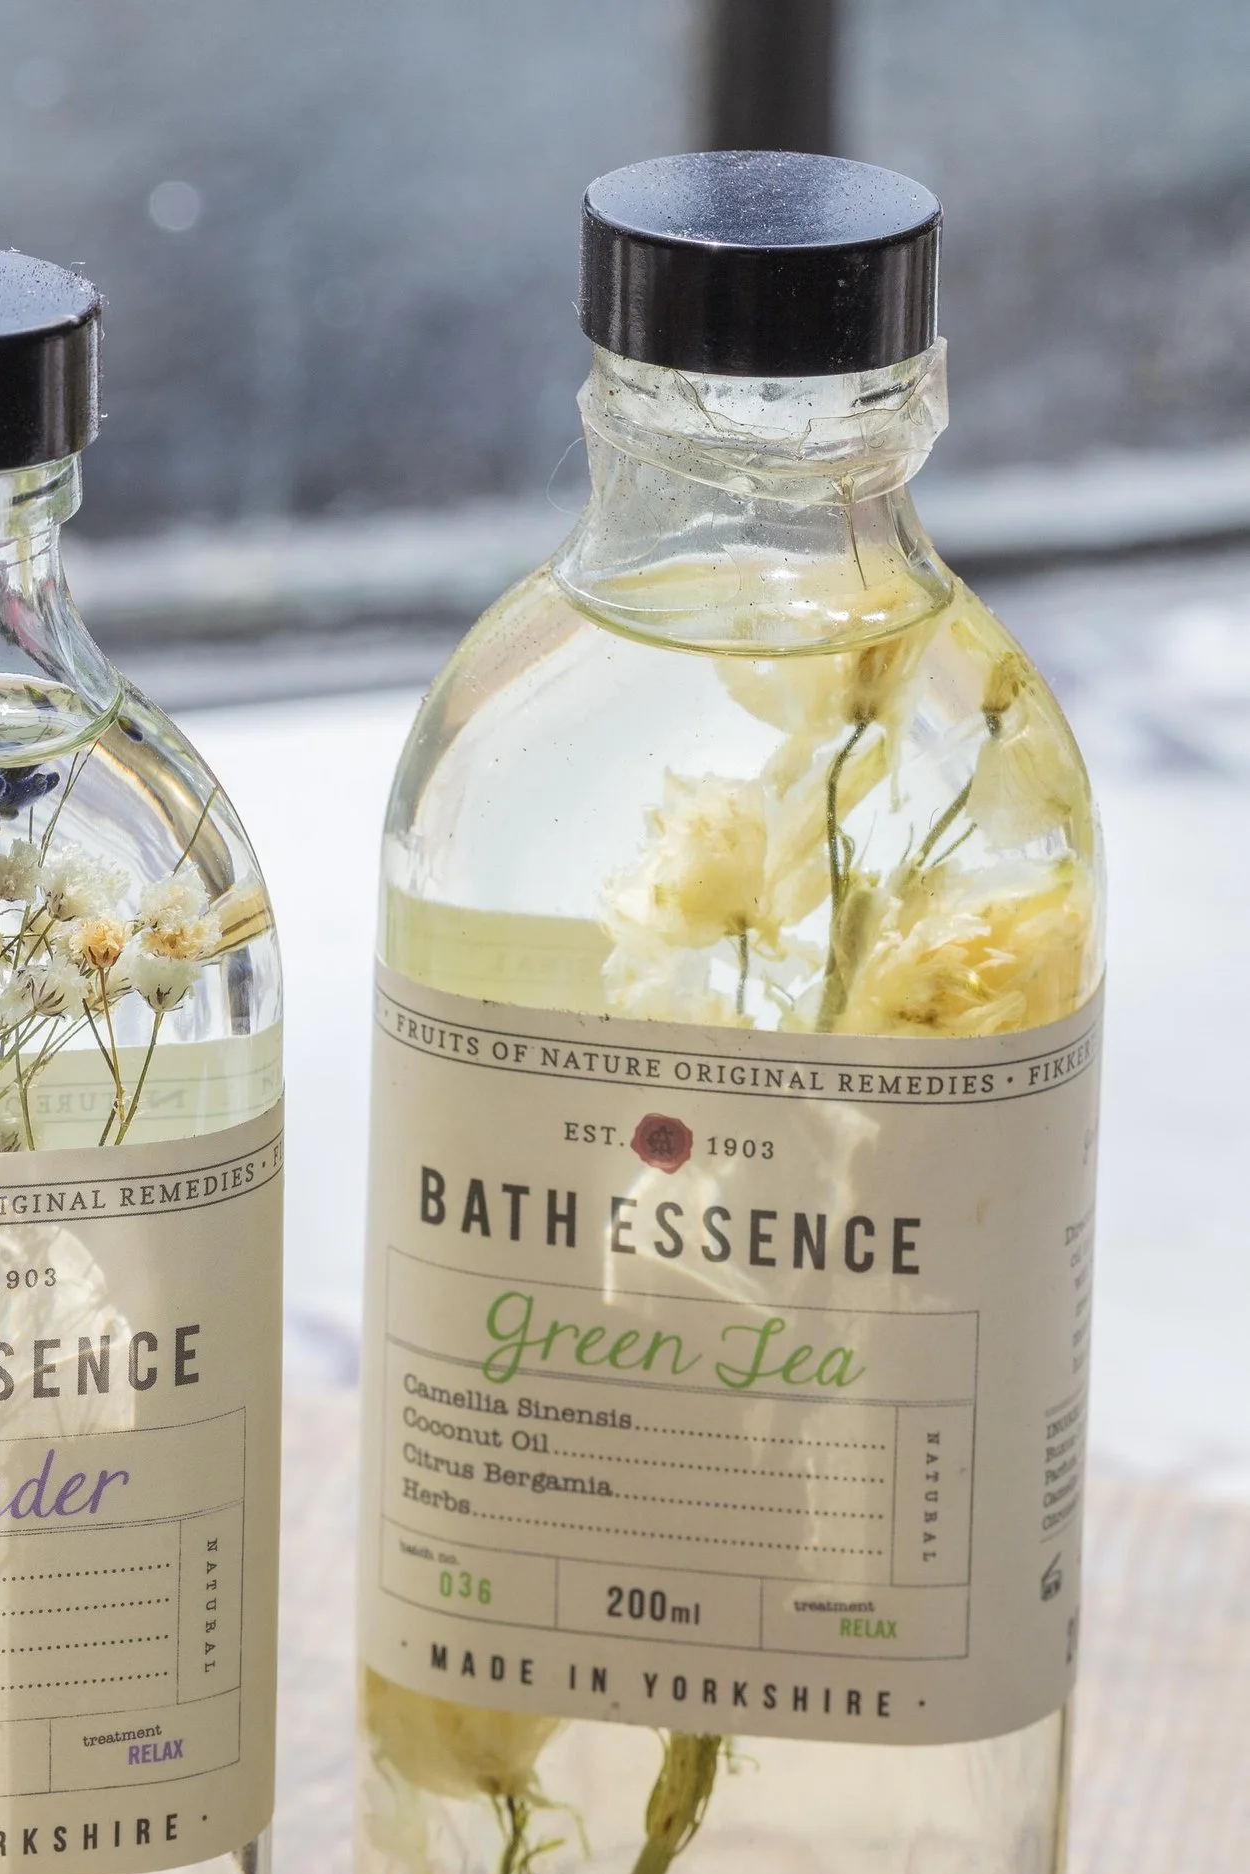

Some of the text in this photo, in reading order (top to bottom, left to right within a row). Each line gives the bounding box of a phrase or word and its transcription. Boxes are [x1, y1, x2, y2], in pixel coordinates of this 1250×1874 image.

[396, 1012, 484, 1058] FRUITS
[493, 1042, 527, 1061] OF
[540, 1048, 661, 1079] NATURE
[674, 1061, 825, 1091] ORIGINAL
[838, 1072, 995, 1095] REMEDIES
[564, 1123, 775, 1160] EST. 1903
[119, 1162, 256, 1205] REMEDIES
[421, 1166, 922, 1275] BATH ESSENCE
[404, 1373, 633, 1430] Camellia Sinensis
[403, 1406, 502, 1448] Coconut
[403, 1443, 474, 1480] Citrus
[924, 1432, 940, 1564] NATURAL
[204, 1538, 219, 1674] NATURAL
[440, 1570, 492, 1604] 036
[607, 1586, 700, 1625] 200ml
[794, 1600, 875, 1612] treatment
[840, 1618, 898, 1639] RELAX
[432, 1643, 892, 1718] MADE IN YORKSHIRE
[82, 1725, 162, 1746] treatment
[128, 1739, 184, 1766] RELAX
